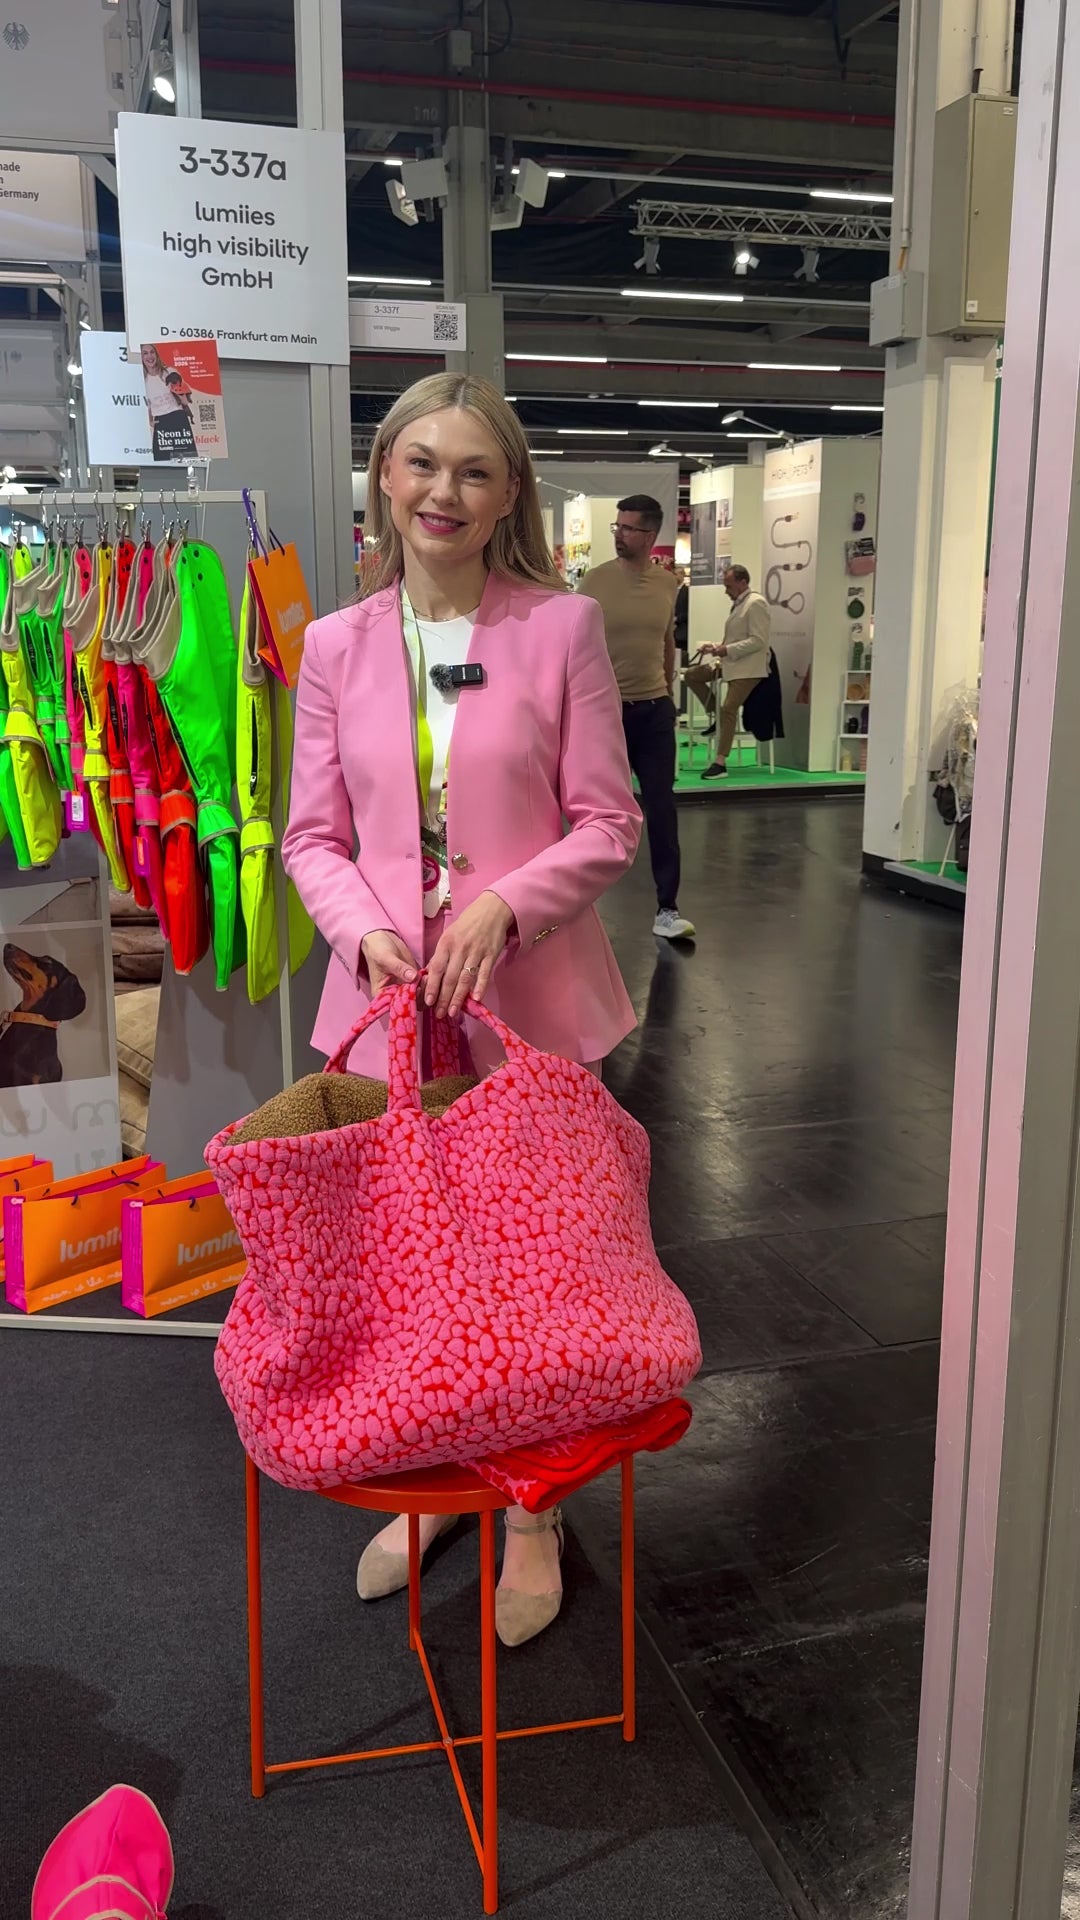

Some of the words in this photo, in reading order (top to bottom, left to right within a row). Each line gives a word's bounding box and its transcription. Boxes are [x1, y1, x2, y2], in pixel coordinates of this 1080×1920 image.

[179, 145, 287, 181] 3-337a
[195, 201, 276, 226] lumiies
[163, 231, 212, 258] high
[217, 236, 309, 265] visibility
[201, 267, 274, 289] GmbH
[374, 305, 400, 315] 3-337f
[160, 326, 170, 336] D
[179, 327, 215, 339] 60386
[217, 330, 268, 342] Frankfurt
[270, 334, 289, 343] am
[290, 334, 318, 345] Main
[112, 394, 140, 406] Willi
[157, 430, 181, 438] Neon
[182, 428, 191, 437] is
[158, 437, 173, 446] the
[195, 434, 220, 444] black
